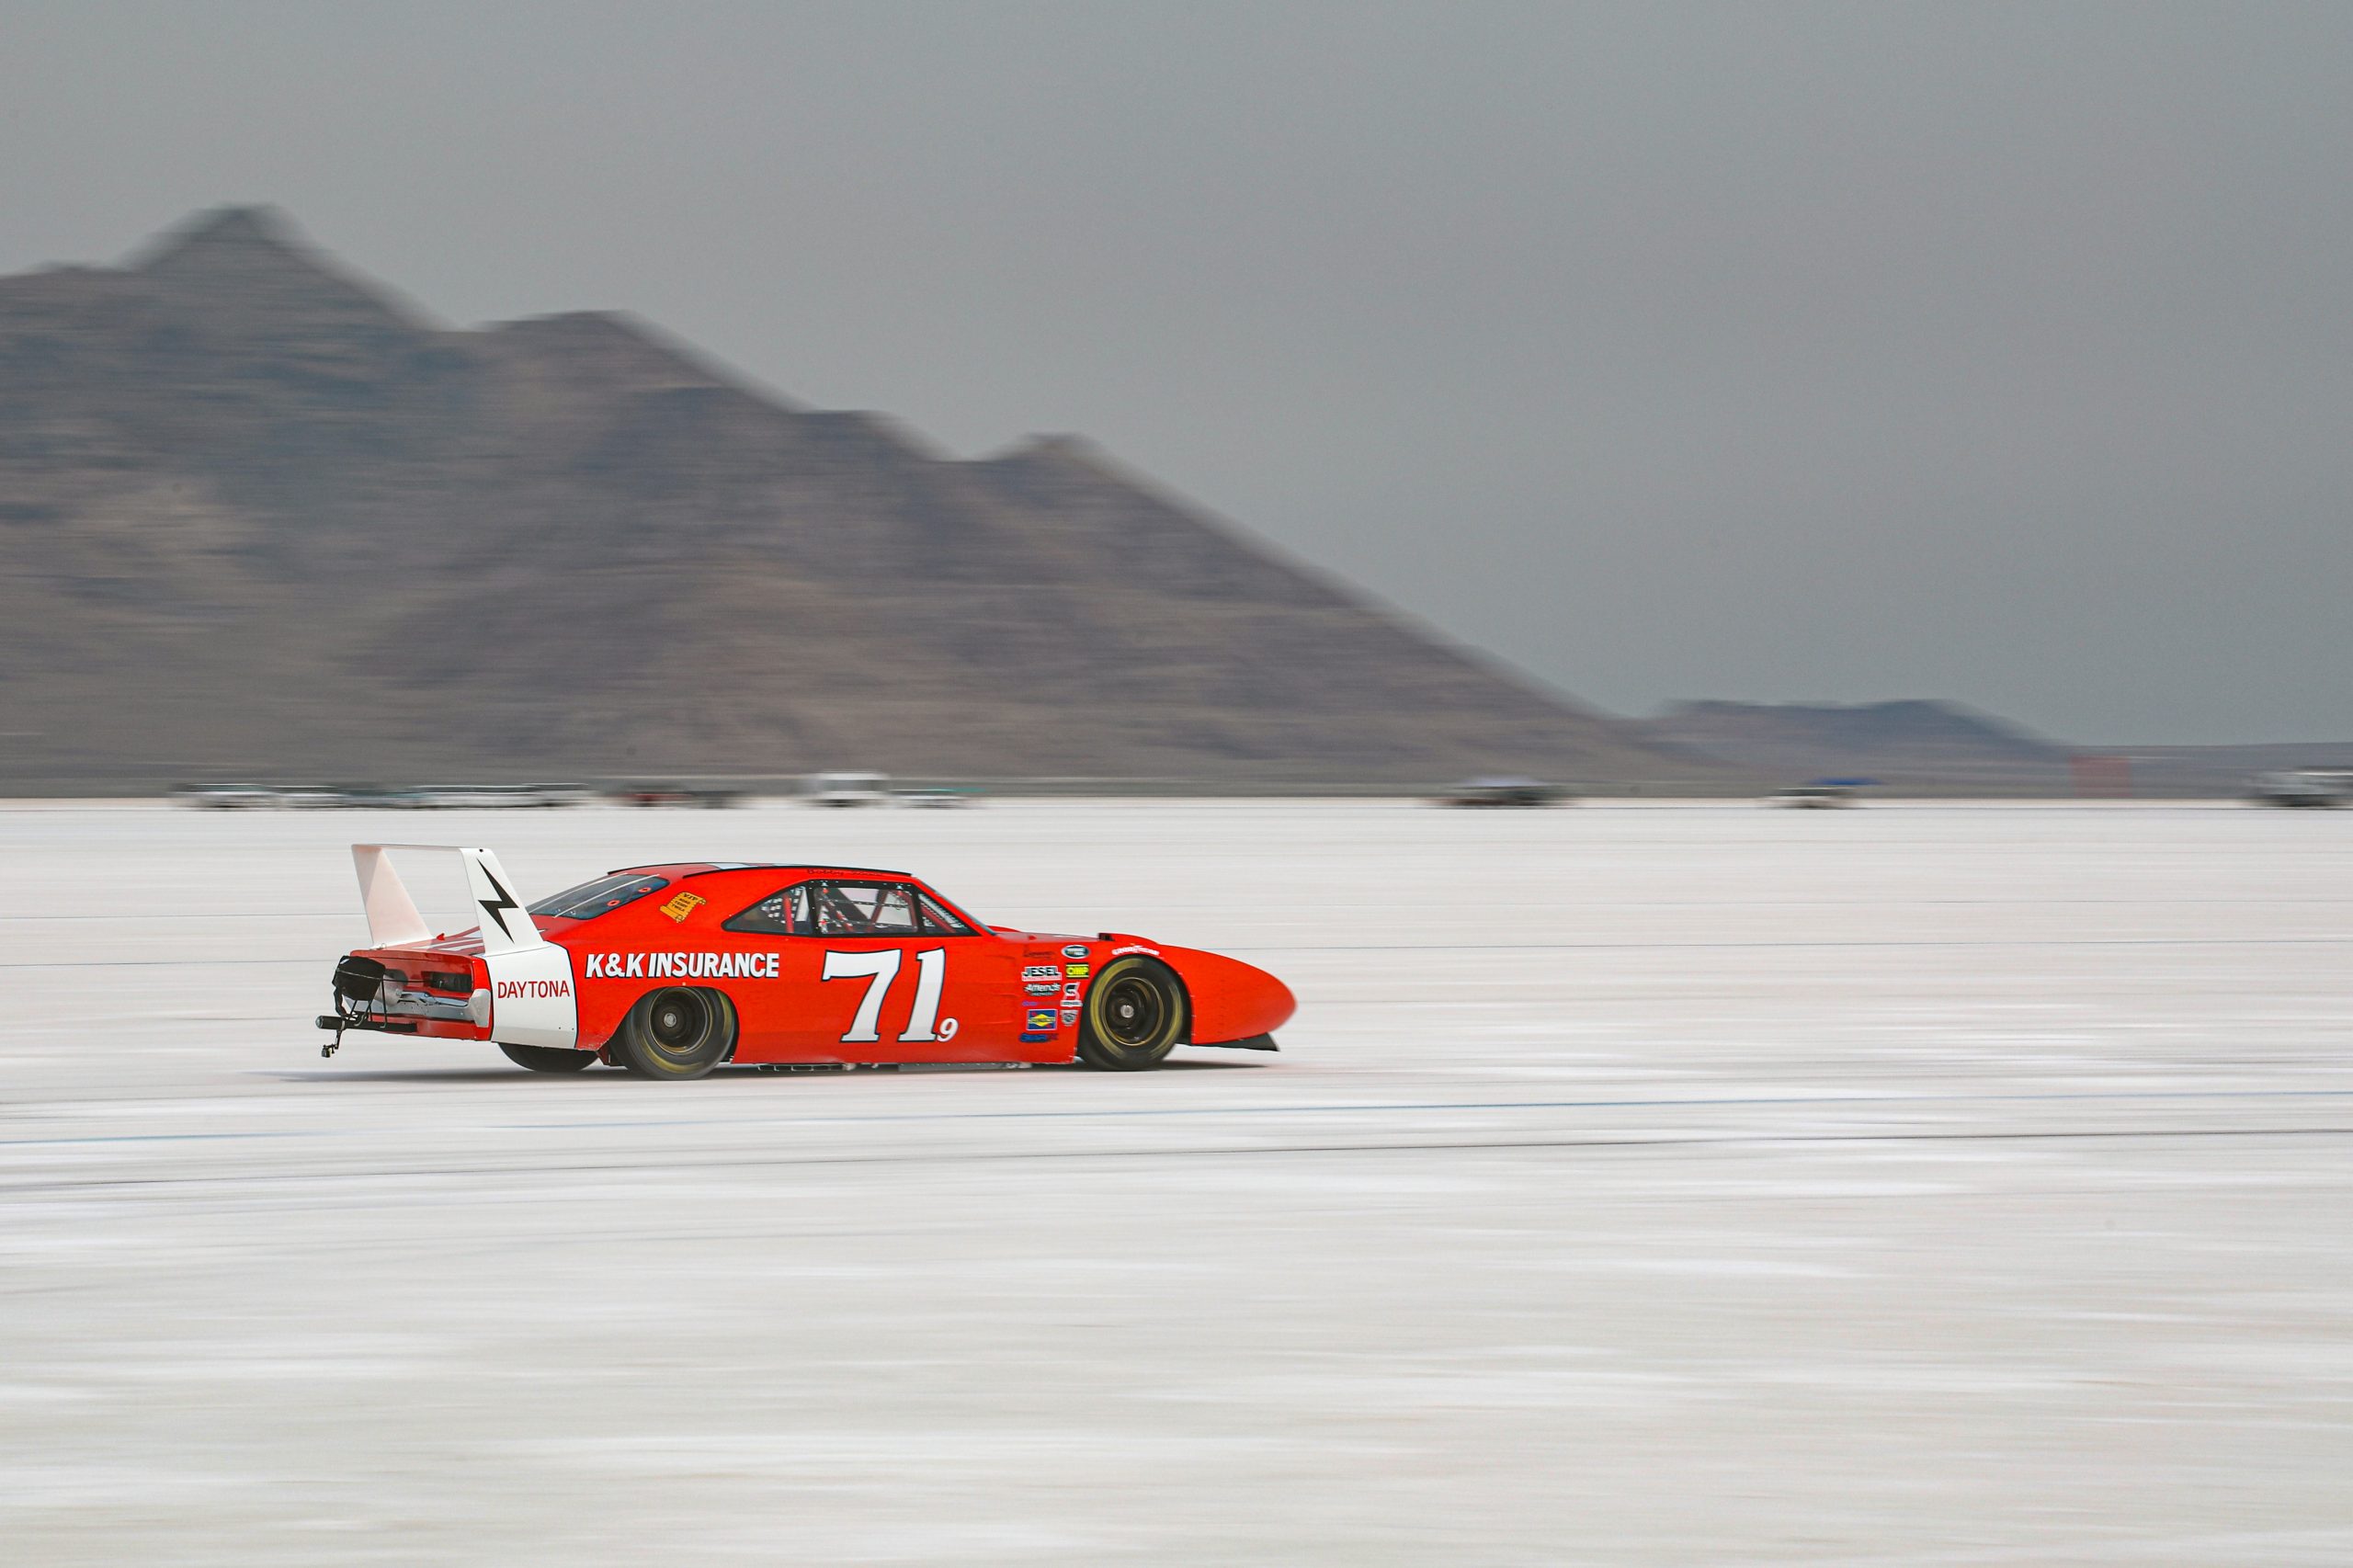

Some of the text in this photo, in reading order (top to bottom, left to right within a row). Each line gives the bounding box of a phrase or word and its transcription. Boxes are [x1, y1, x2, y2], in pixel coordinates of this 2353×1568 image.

[585, 952, 779, 979] K&K INSURANCE
[1023, 966, 1059, 977] JESEL
[1066, 966, 1089, 976] OMP
[497, 980, 570, 999] DAYTONA
[820, 945, 947, 1043] 71
[936, 1017, 960, 1043] 9
